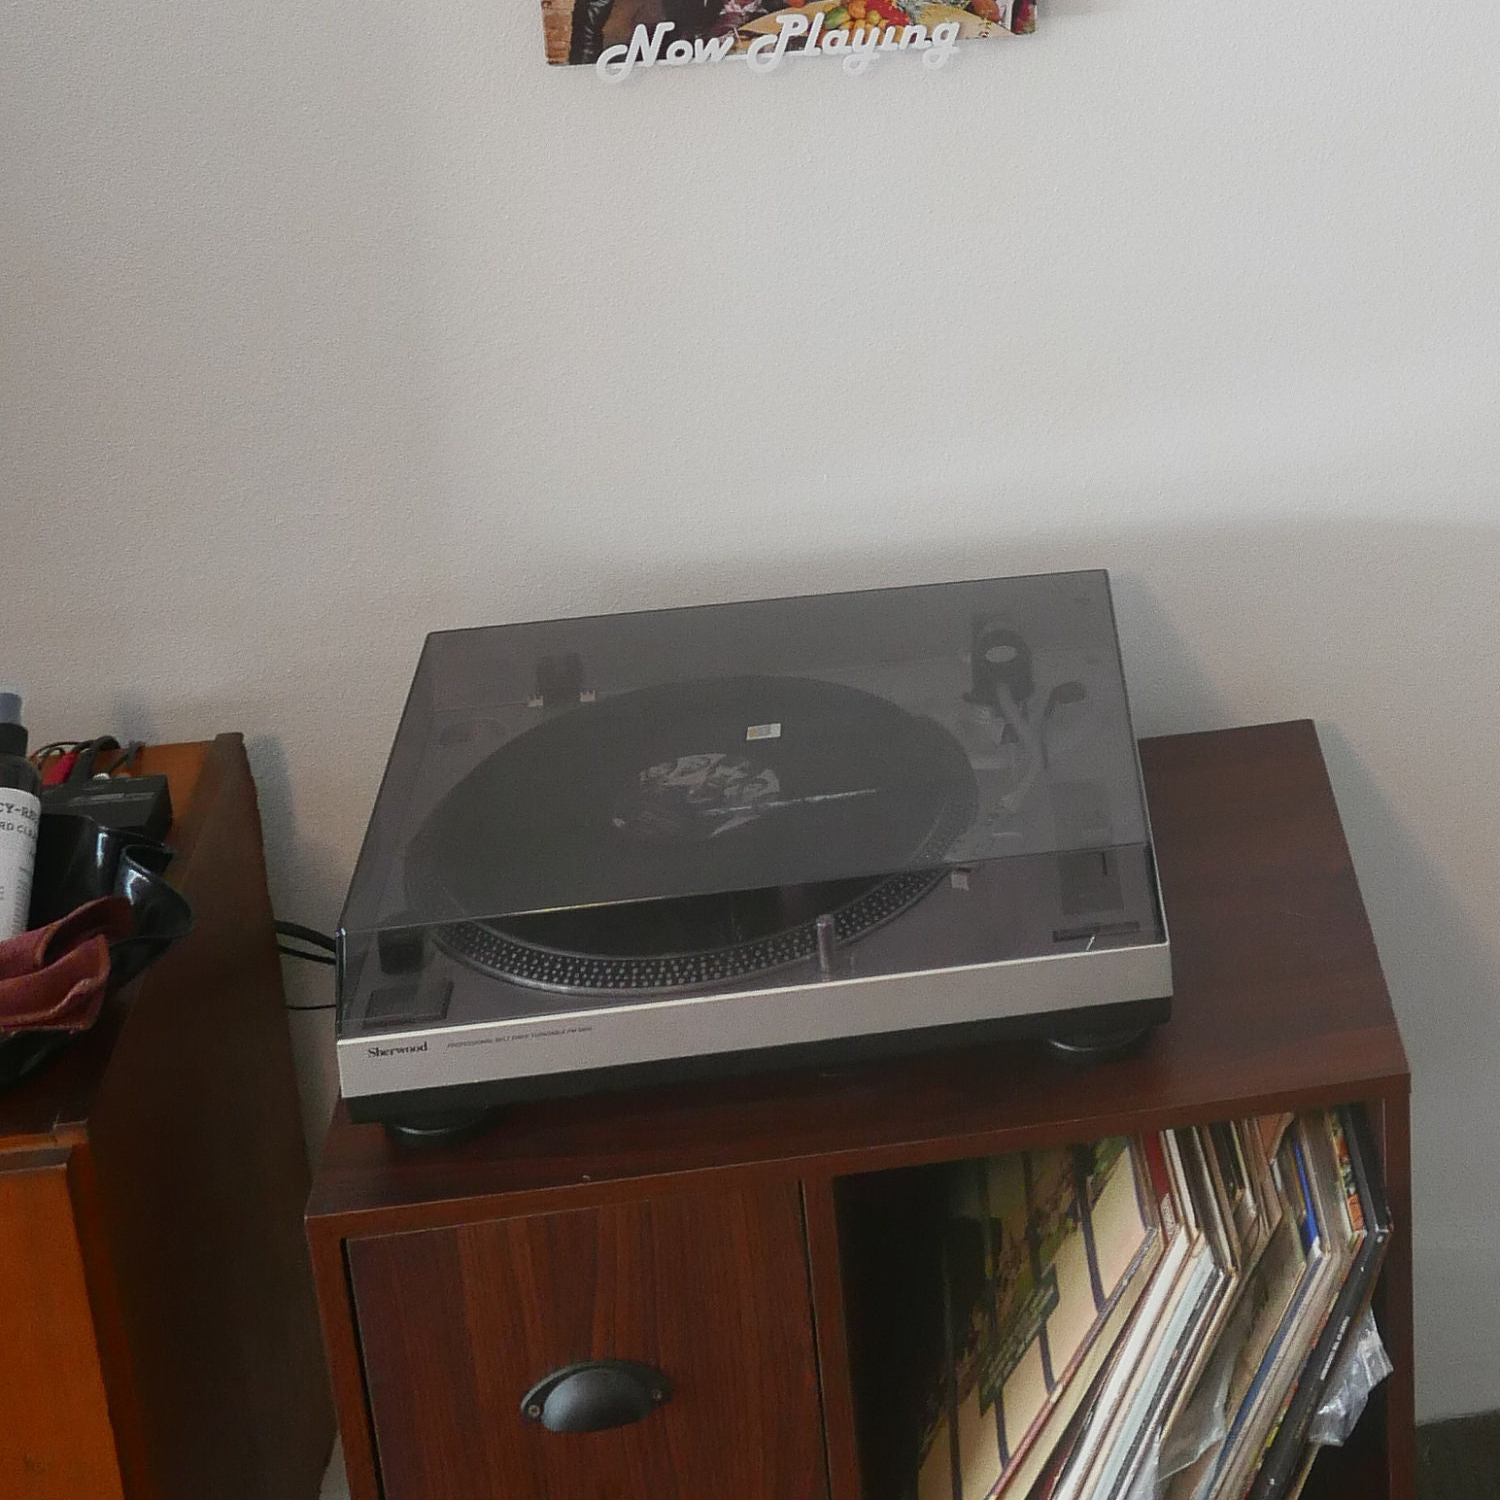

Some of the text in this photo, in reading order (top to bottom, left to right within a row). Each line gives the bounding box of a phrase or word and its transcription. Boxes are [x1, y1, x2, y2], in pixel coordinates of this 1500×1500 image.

[596, 11, 962, 85] Now Playing
[368, 1041, 428, 1058] Sherwood
